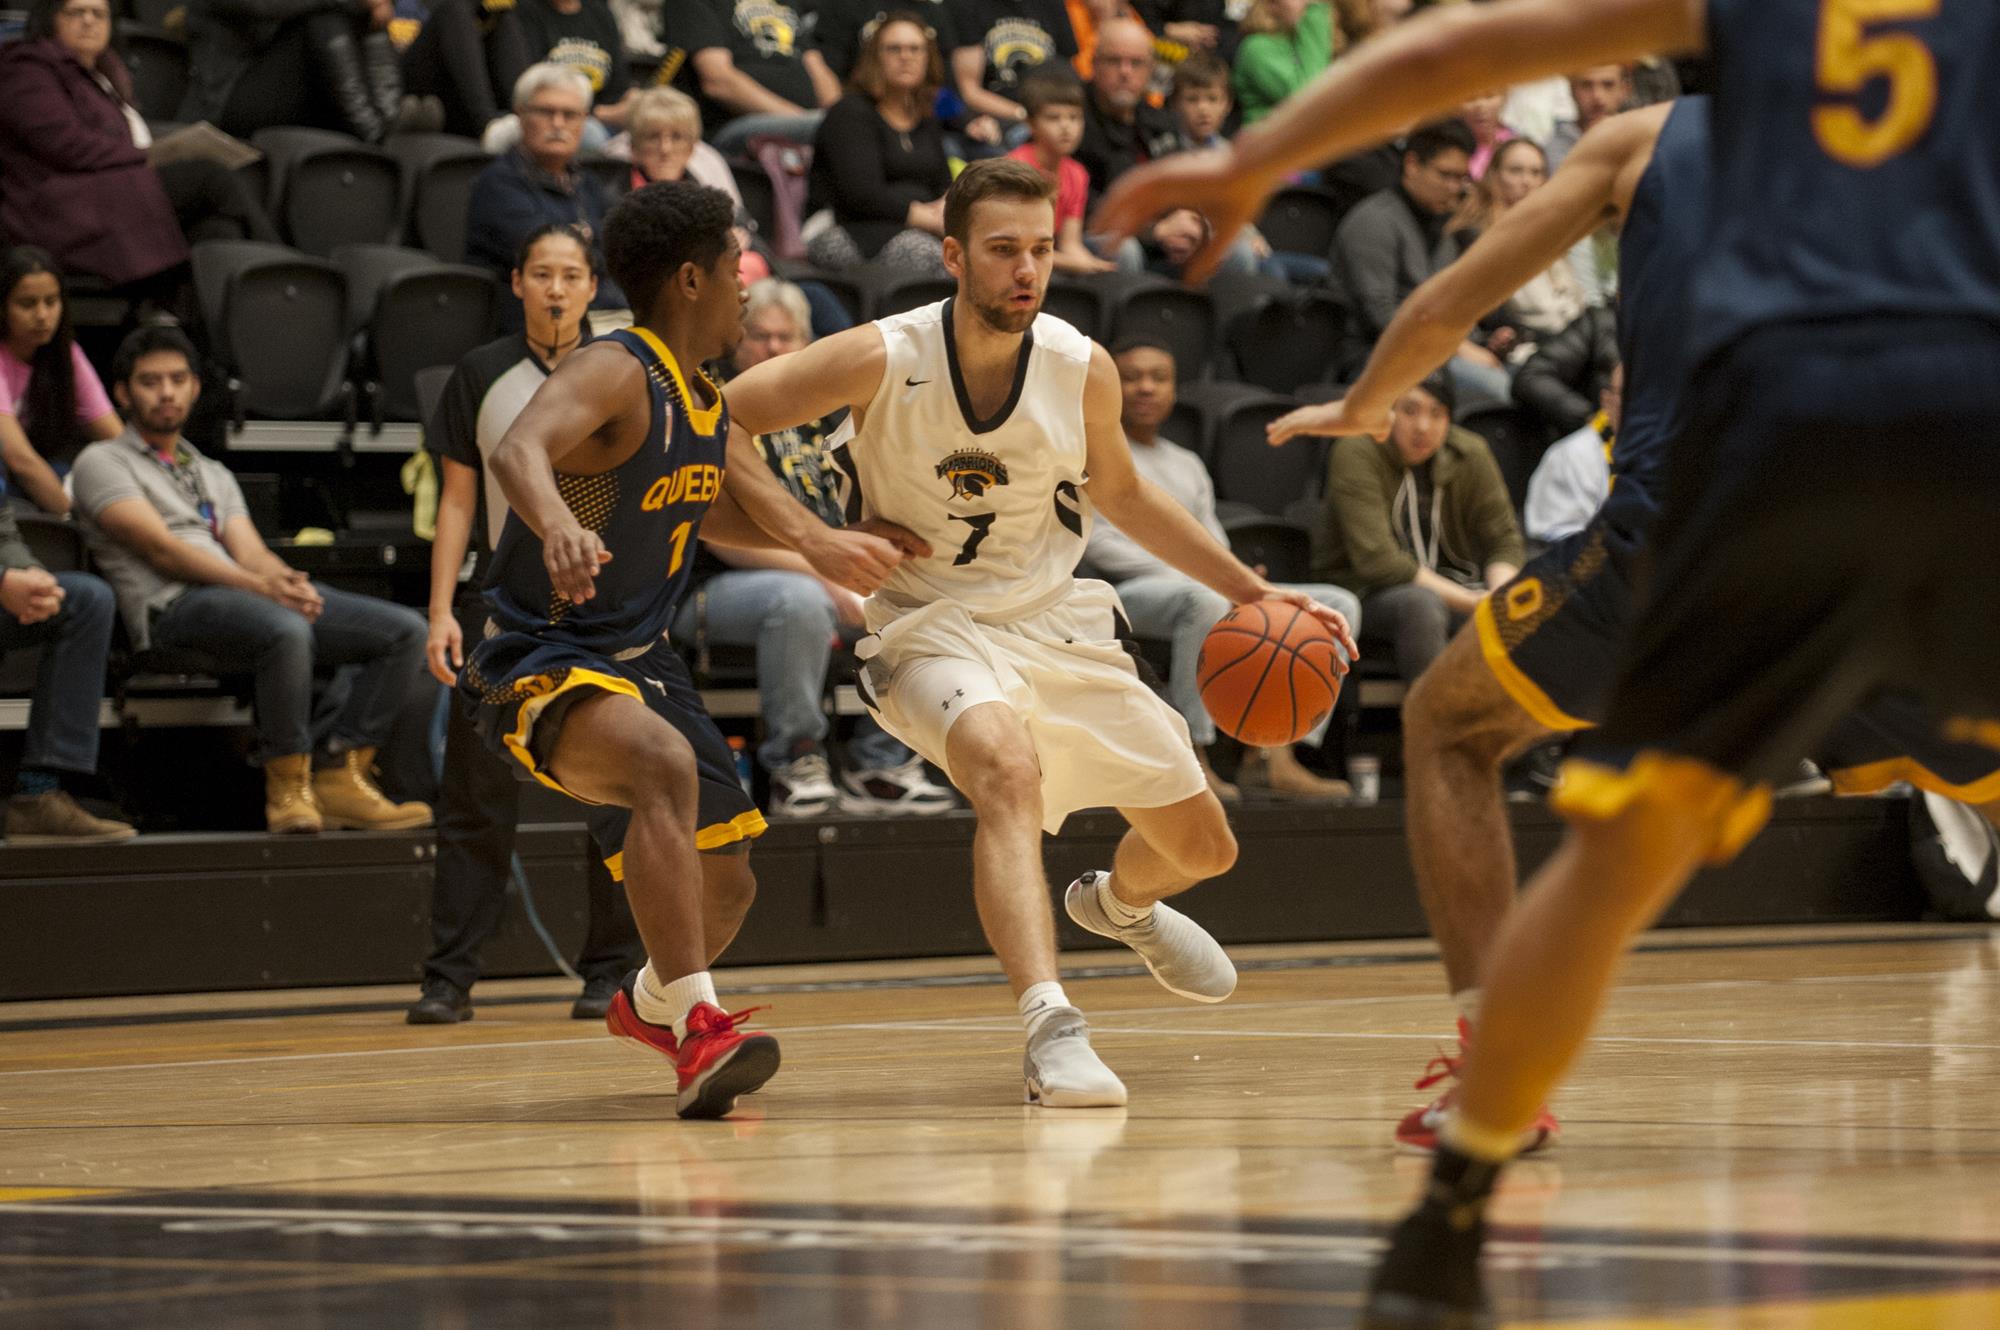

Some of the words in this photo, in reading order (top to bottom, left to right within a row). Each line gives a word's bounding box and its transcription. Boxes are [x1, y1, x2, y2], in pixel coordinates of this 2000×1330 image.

[1810, 0, 1942, 171] 5
[934, 454, 1009, 486] WARRIORS
[667, 520, 694, 579] 1
[948, 512, 996, 566] 7
